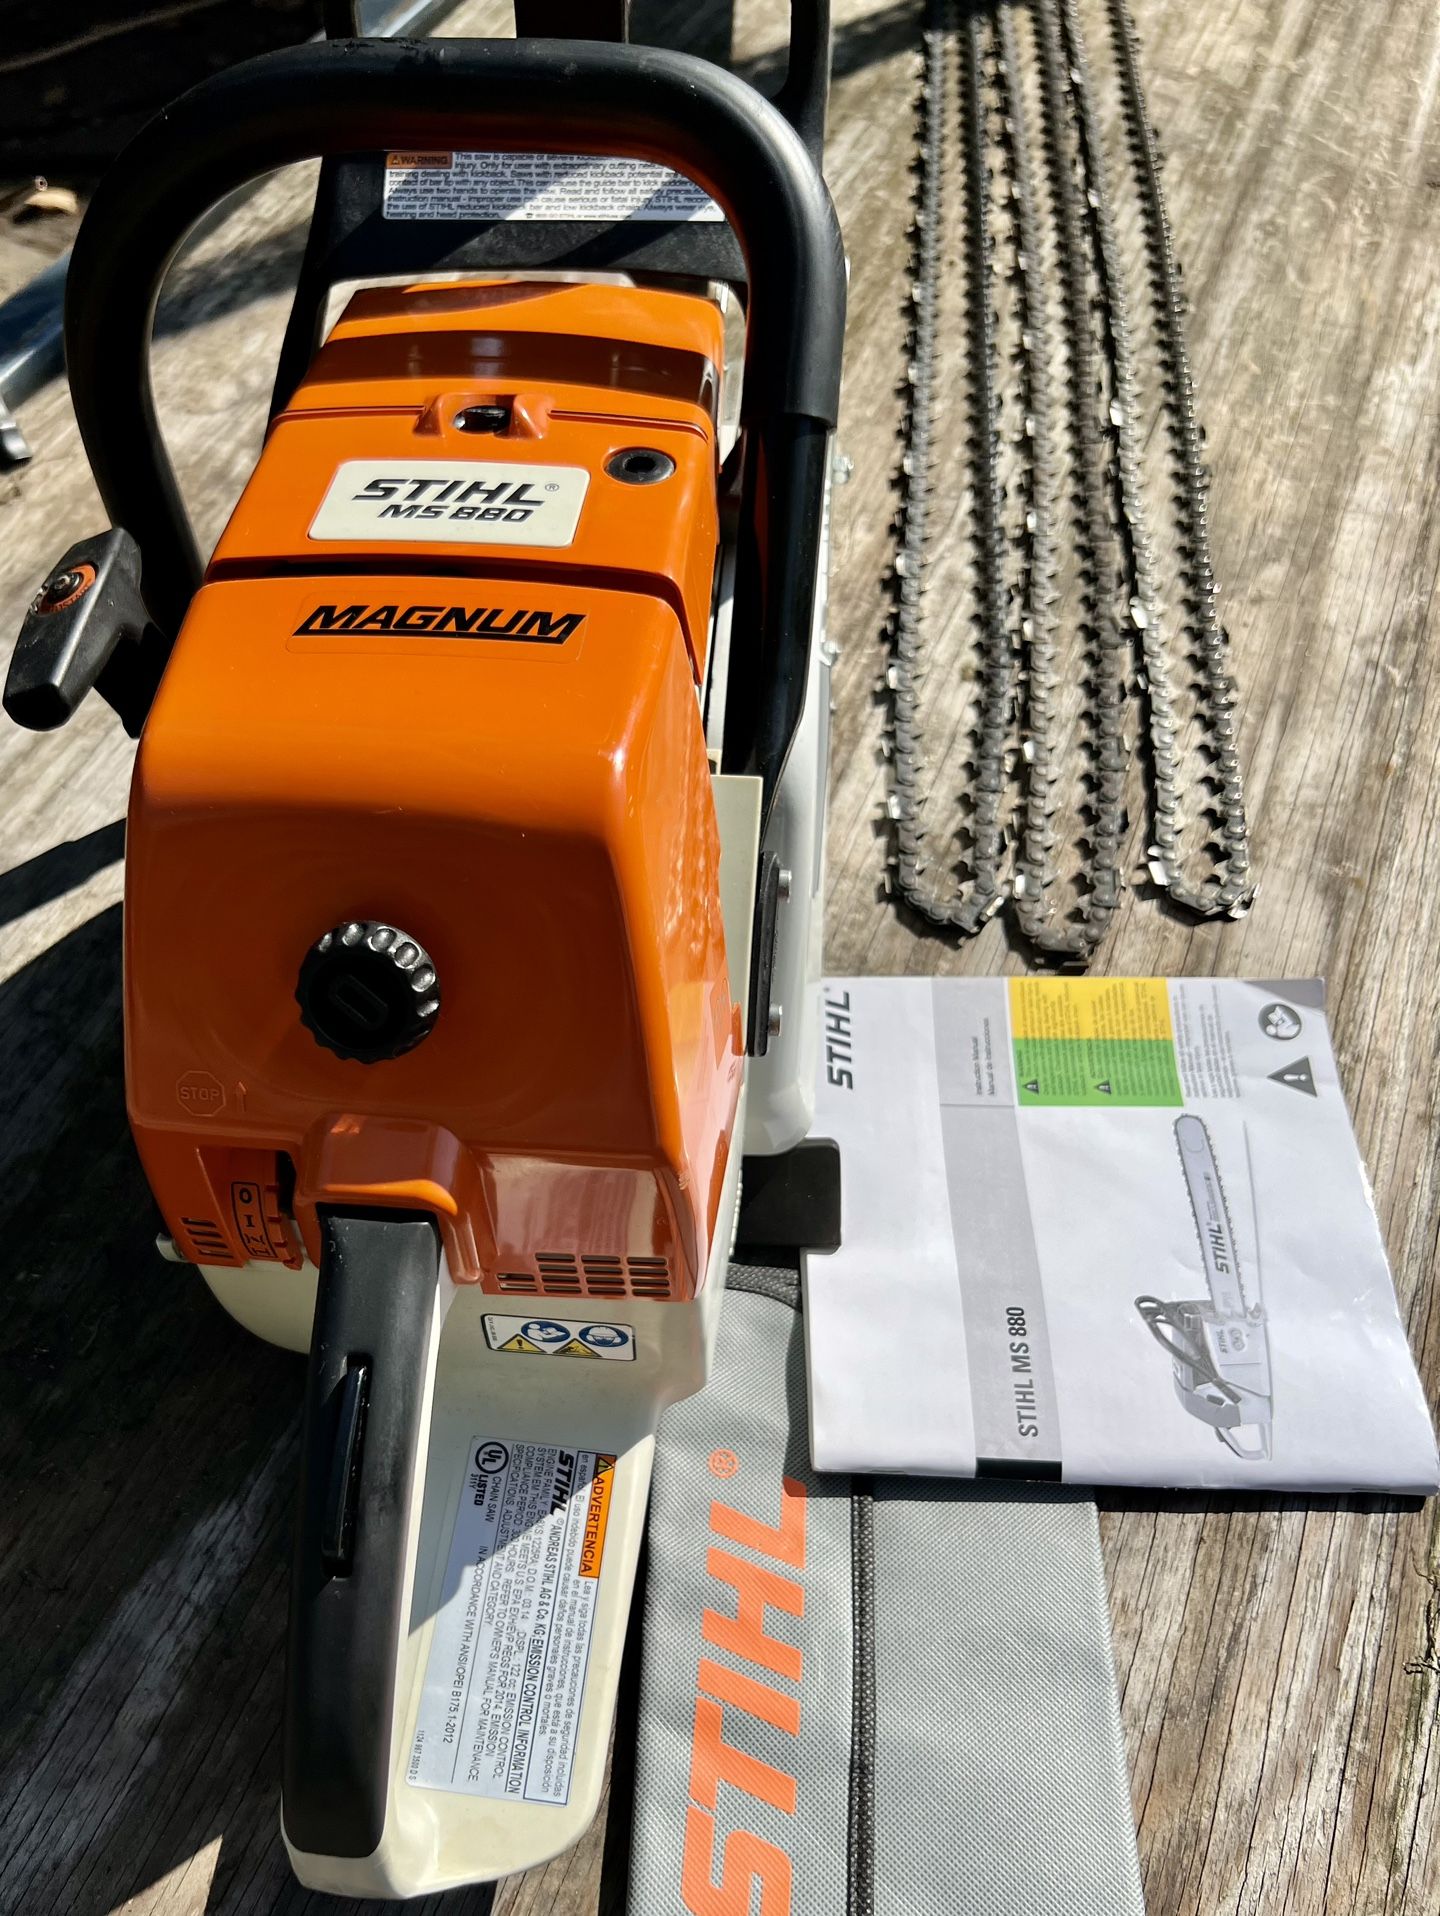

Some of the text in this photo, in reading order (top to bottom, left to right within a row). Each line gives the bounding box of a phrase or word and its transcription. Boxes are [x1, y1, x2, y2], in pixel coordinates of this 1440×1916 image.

[401, 155, 449, 166] WARNING
[351, 479, 546, 507] STIHL
[376, 505, 535, 522] MS 880
[292, 604, 588, 645] MAGNUM
[825, 991, 853, 1090] STIHL
[180, 1086, 220, 1102] STOP
[1208, 1223, 1230, 1275] STIHL
[1006, 1306, 1038, 1438] STIHL MS 880
[517, 1445, 535, 1494] COMPLIANCE
[543, 1448, 557, 1476] ENGINE
[580, 1454, 589, 1462] en
[473, 1473, 488, 1506] LISTED
[488, 1475, 501, 1501] CHAIN
[549, 1449, 575, 1517] STIHL
[484, 1502, 496, 1522] SAW
[527, 1491, 539, 1509] THIS
[572, 1503, 582, 1516] uso
[494, 1509, 513, 1560] ADJUSTMENT
[509, 1528, 520, 1542] 300
[521, 1511, 536, 1541] ENGINE
[567, 1517, 581, 1548] indebido
[581, 1476, 605, 1573] ADVERTENCIA
[478, 1545, 488, 1554] IN
[516, 1542, 530, 1569] MEETS
[545, 1524, 561, 1562] ANDREAS
[491, 1561, 503, 1579] AND
[563, 1548, 576, 1571] puede
[466, 1556, 485, 1616] ACCORDANCE
[540, 1562, 555, 1585] STIHL
[559, 1572, 571, 1597] causar
[571, 1578, 580, 1588] en
[497, 1577, 512, 1606] REFER
[510, 1588, 522, 1605] EPA
[538, 1586, 552, 1599] AG
[582, 1580, 593, 1594] Lea
[495, 1606, 507, 1618] TO
[556, 1598, 568, 1621] daños
[566, 1598, 578, 1626] manual
[575, 1602, 590, 1618] siga
[461, 1618, 474, 1642] WITH
[547, 1622, 564, 1664] personales
[564, 1626, 574, 1638] de
[575, 1619, 587, 1641] todas
[499, 1644, 513, 1668] REGS
[525, 1637, 543, 1681] EMISSION
[573, 1641, 584, 1654] las
[482, 1660, 497, 1695] MANUAL
[495, 1669, 508, 1688] FOR
[509, 1662, 520, 1676] 122
[543, 1665, 557, 1692] graves
[562, 1654, 581, 1706] precauciones
[478, 1697, 491, 1715] FOR
[518, 1682, 536, 1727] CONTROL
[551, 1692, 563, 1707] que
[680, 1475, 807, 1916] STIHL
[499, 1692, 515, 1734] EMISSION
[550, 1710, 561, 1726] está
[564, 1708, 575, 1719] de
[483, 1713, 501, 1756] EMISSION
[547, 1735, 556, 1746] su
[556, 1720, 572, 1759] seguridad
[492, 1736, 508, 1779] CONTROL
[506, 1728, 529, 1794] INFORMATION
[538, 1748, 556, 1792] disposición
[552, 1761, 567, 1797] incluidas
